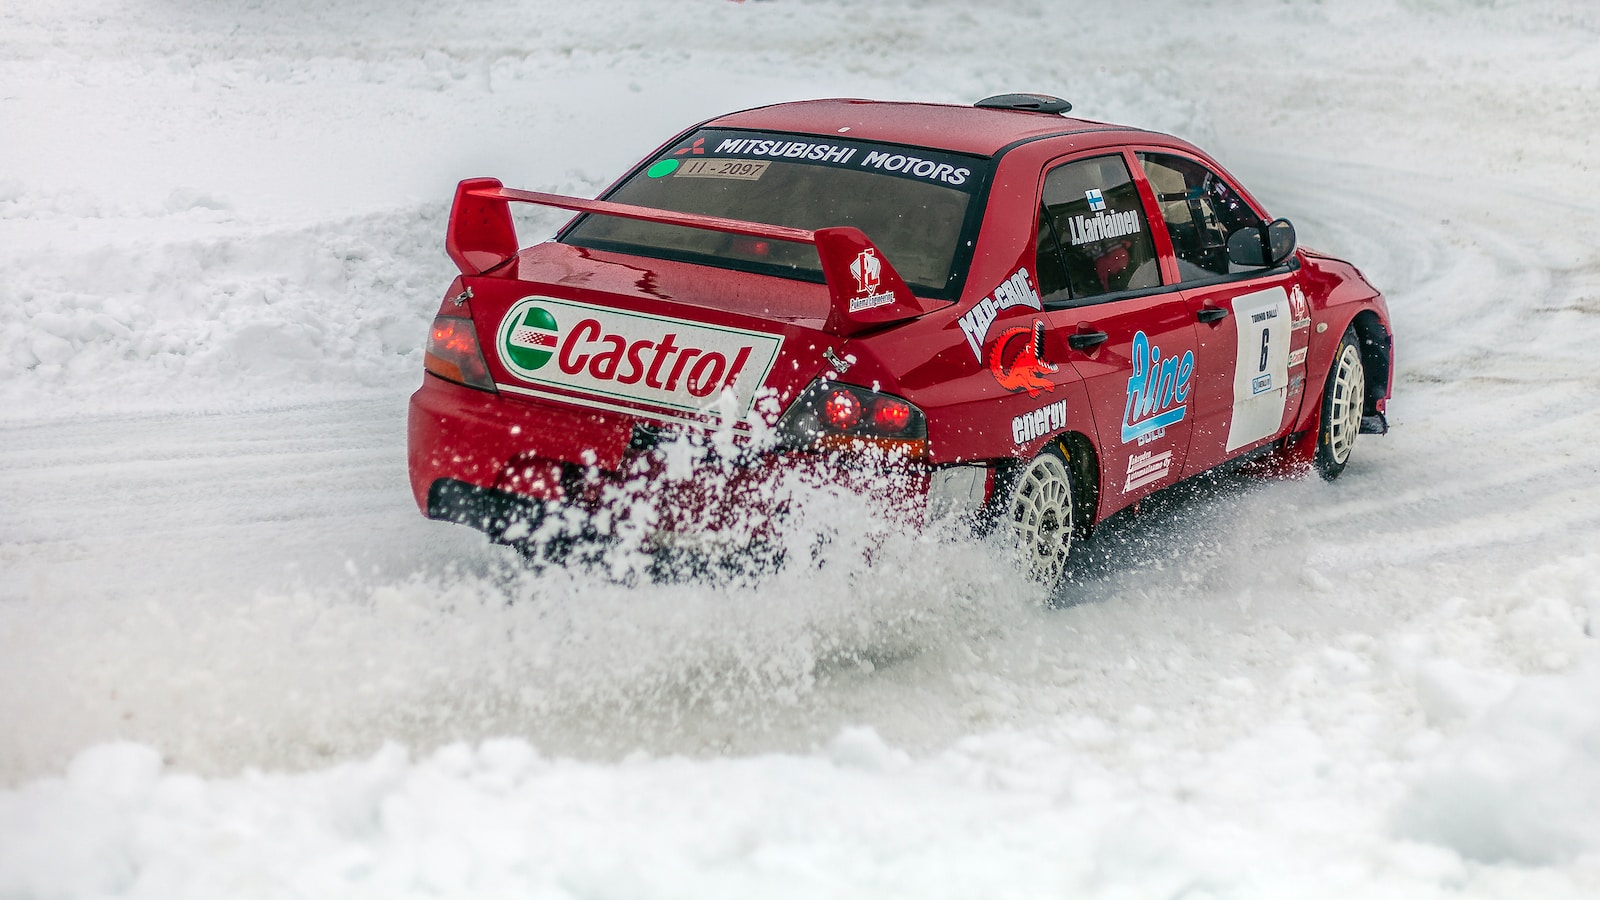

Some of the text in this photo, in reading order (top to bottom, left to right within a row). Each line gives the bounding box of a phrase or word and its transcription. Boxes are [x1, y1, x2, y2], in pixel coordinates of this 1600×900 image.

[714, 138, 971, 185] MITSUBISHI MOTORS
[718, 162, 764, 176] 2097
[1068, 209, 1141, 246] J.Karilainen
[957, 266, 1041, 367] MAD-CROC
[558, 318, 753, 399] Castrol
[1259, 327, 1270, 372] 6
[1121, 330, 1195, 443] Aine
[1012, 400, 1067, 445] energy
